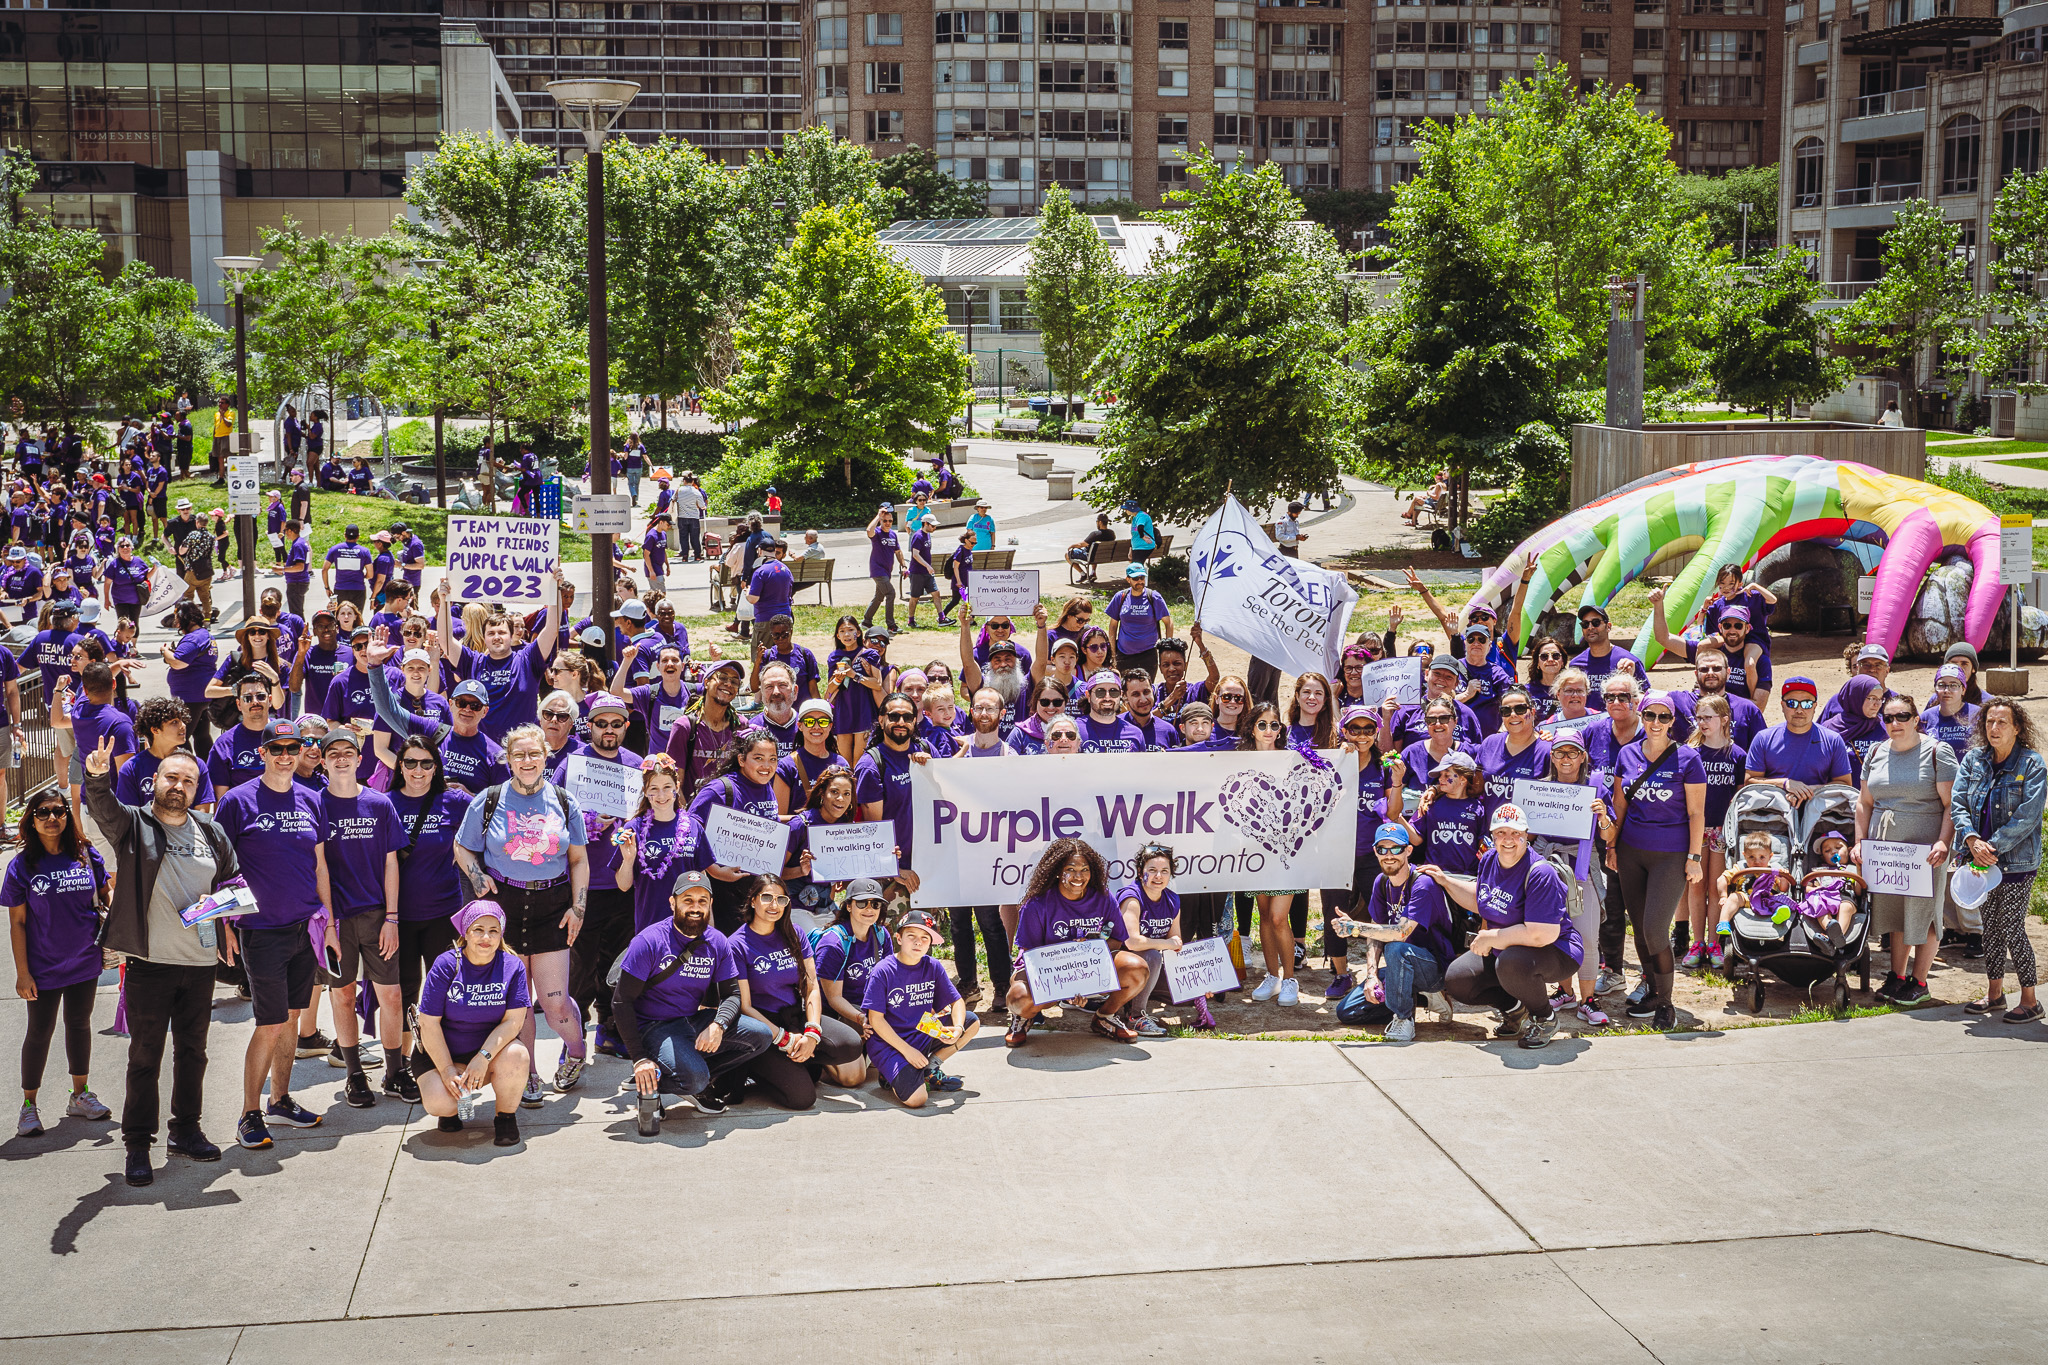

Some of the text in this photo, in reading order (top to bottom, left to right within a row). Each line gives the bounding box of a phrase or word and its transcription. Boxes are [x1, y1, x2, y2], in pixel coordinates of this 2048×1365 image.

[79, 132, 157, 140] HOMESENSE
[452, 520, 550, 536] TEAM WENDY
[459, 536, 550, 553] AND FRIENDS
[450, 552, 554, 573] PURPLE WALK
[461, 575, 542, 598] 2023
[1242, 596, 1268, 618] See
[1270, 613, 1294, 636] the
[40, 642, 64, 654] TEAM
[1377, 674, 1400, 683] walking
[444, 750, 480, 766] EPILEPSY
[446, 759, 474, 772] Toronto
[586, 761, 604, 770] Purple
[1703, 761, 1735, 773] PILEPSY
[578, 775, 638, 794] I'm walking for
[1492, 774, 1508, 784] Walk
[1651, 780, 1663, 788] for
[1538, 801, 1569, 811] walking
[276, 812, 312, 820] EPILEPSY
[727, 813, 762, 827] Purple Walk
[934, 790, 1215, 853] Purple Walk
[1528, 811, 1564, 820] CHIARA
[338, 818, 378, 828] EPILEPSY
[1437, 821, 1456, 830] Walk
[716, 827, 777, 849] I'm walking for
[837, 843, 870, 851] walking
[834, 853, 881, 876] KIM
[992, 846, 1266, 886] for oronto
[1881, 860, 1910, 870] walking
[51, 868, 90, 880] EPILEPSY
[1874, 868, 1910, 891] Daddy
[58, 877, 90, 887] Toronto
[1070, 917, 1103, 926] EPILEPSY
[683, 963, 710, 973] Toronto
[1054, 961, 1088, 972] walking
[1188, 959, 1214, 970] walking
[1175, 966, 1222, 993] MARJAN
[466, 981, 507, 993] EPILEPSY
[906, 981, 935, 993] EPILEPS
[1035, 976, 1051, 996] My
[471, 992, 504, 1000] Toronto
